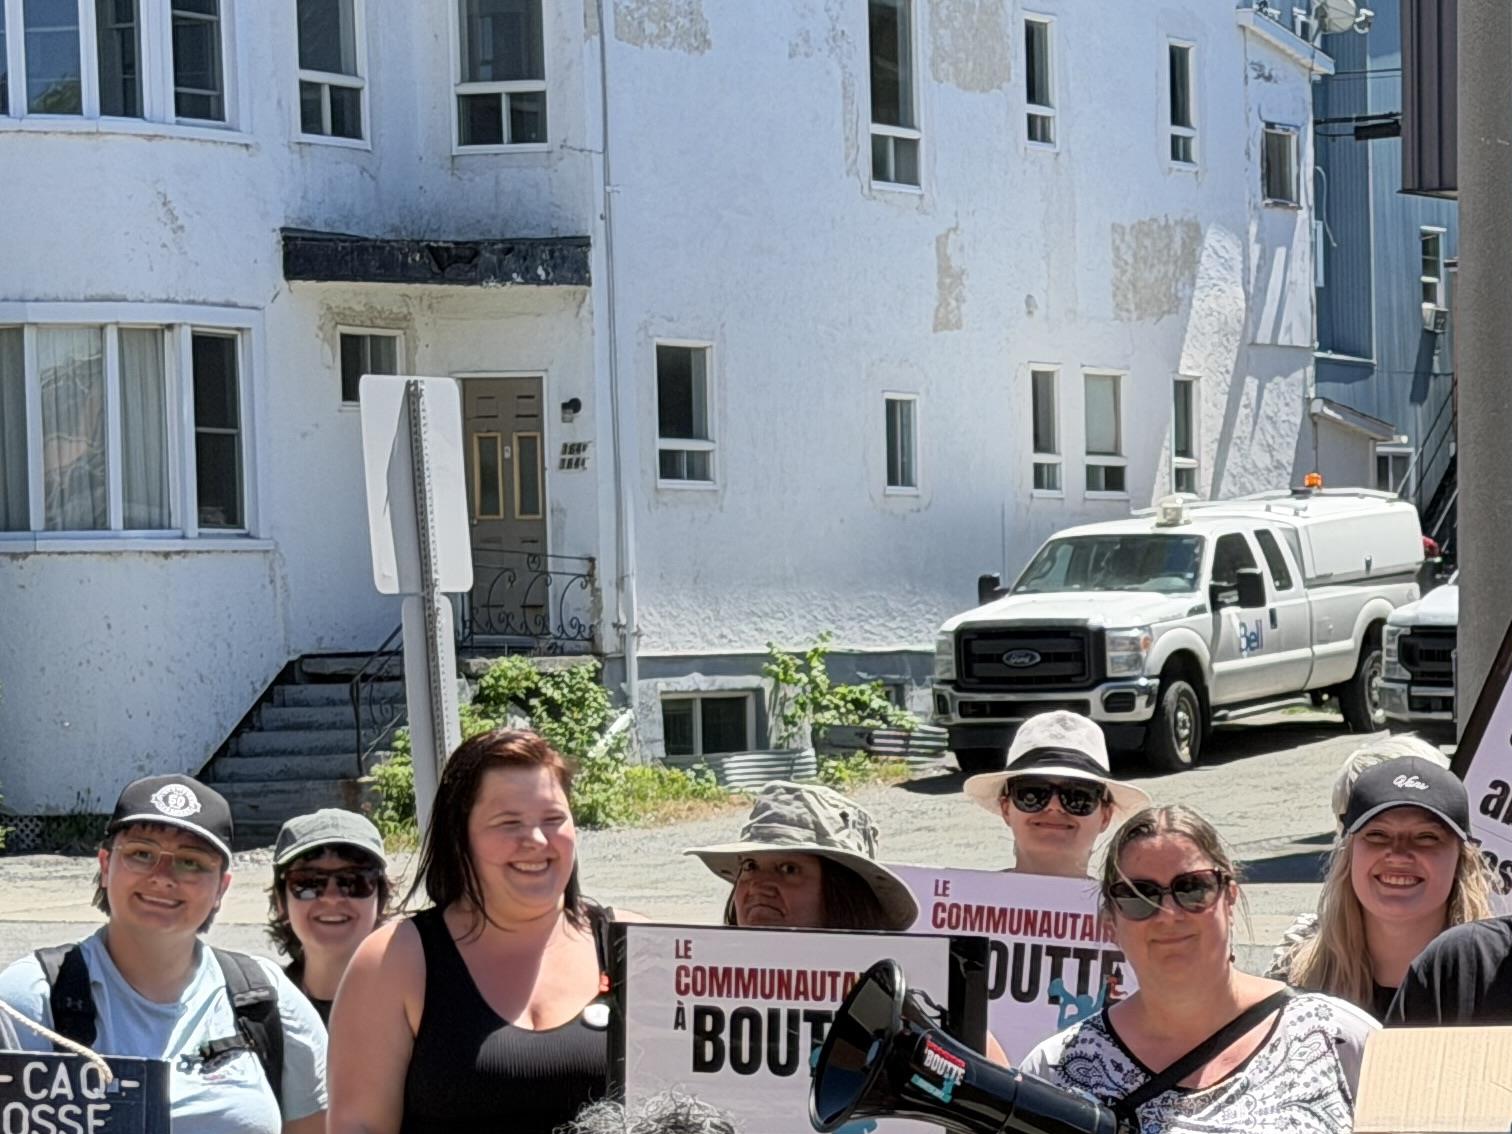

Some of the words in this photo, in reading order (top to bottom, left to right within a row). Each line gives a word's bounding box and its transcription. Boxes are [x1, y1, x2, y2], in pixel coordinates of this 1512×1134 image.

[934, 879, 950, 897] LE
[675, 939, 692, 959] LE
[675, 965, 863, 1002] COMMUNAUTA
[987, 940, 1126, 1006] OUTTE
[674, 1000, 687, 1030] À
[693, 1005, 837, 1077] BOUT
